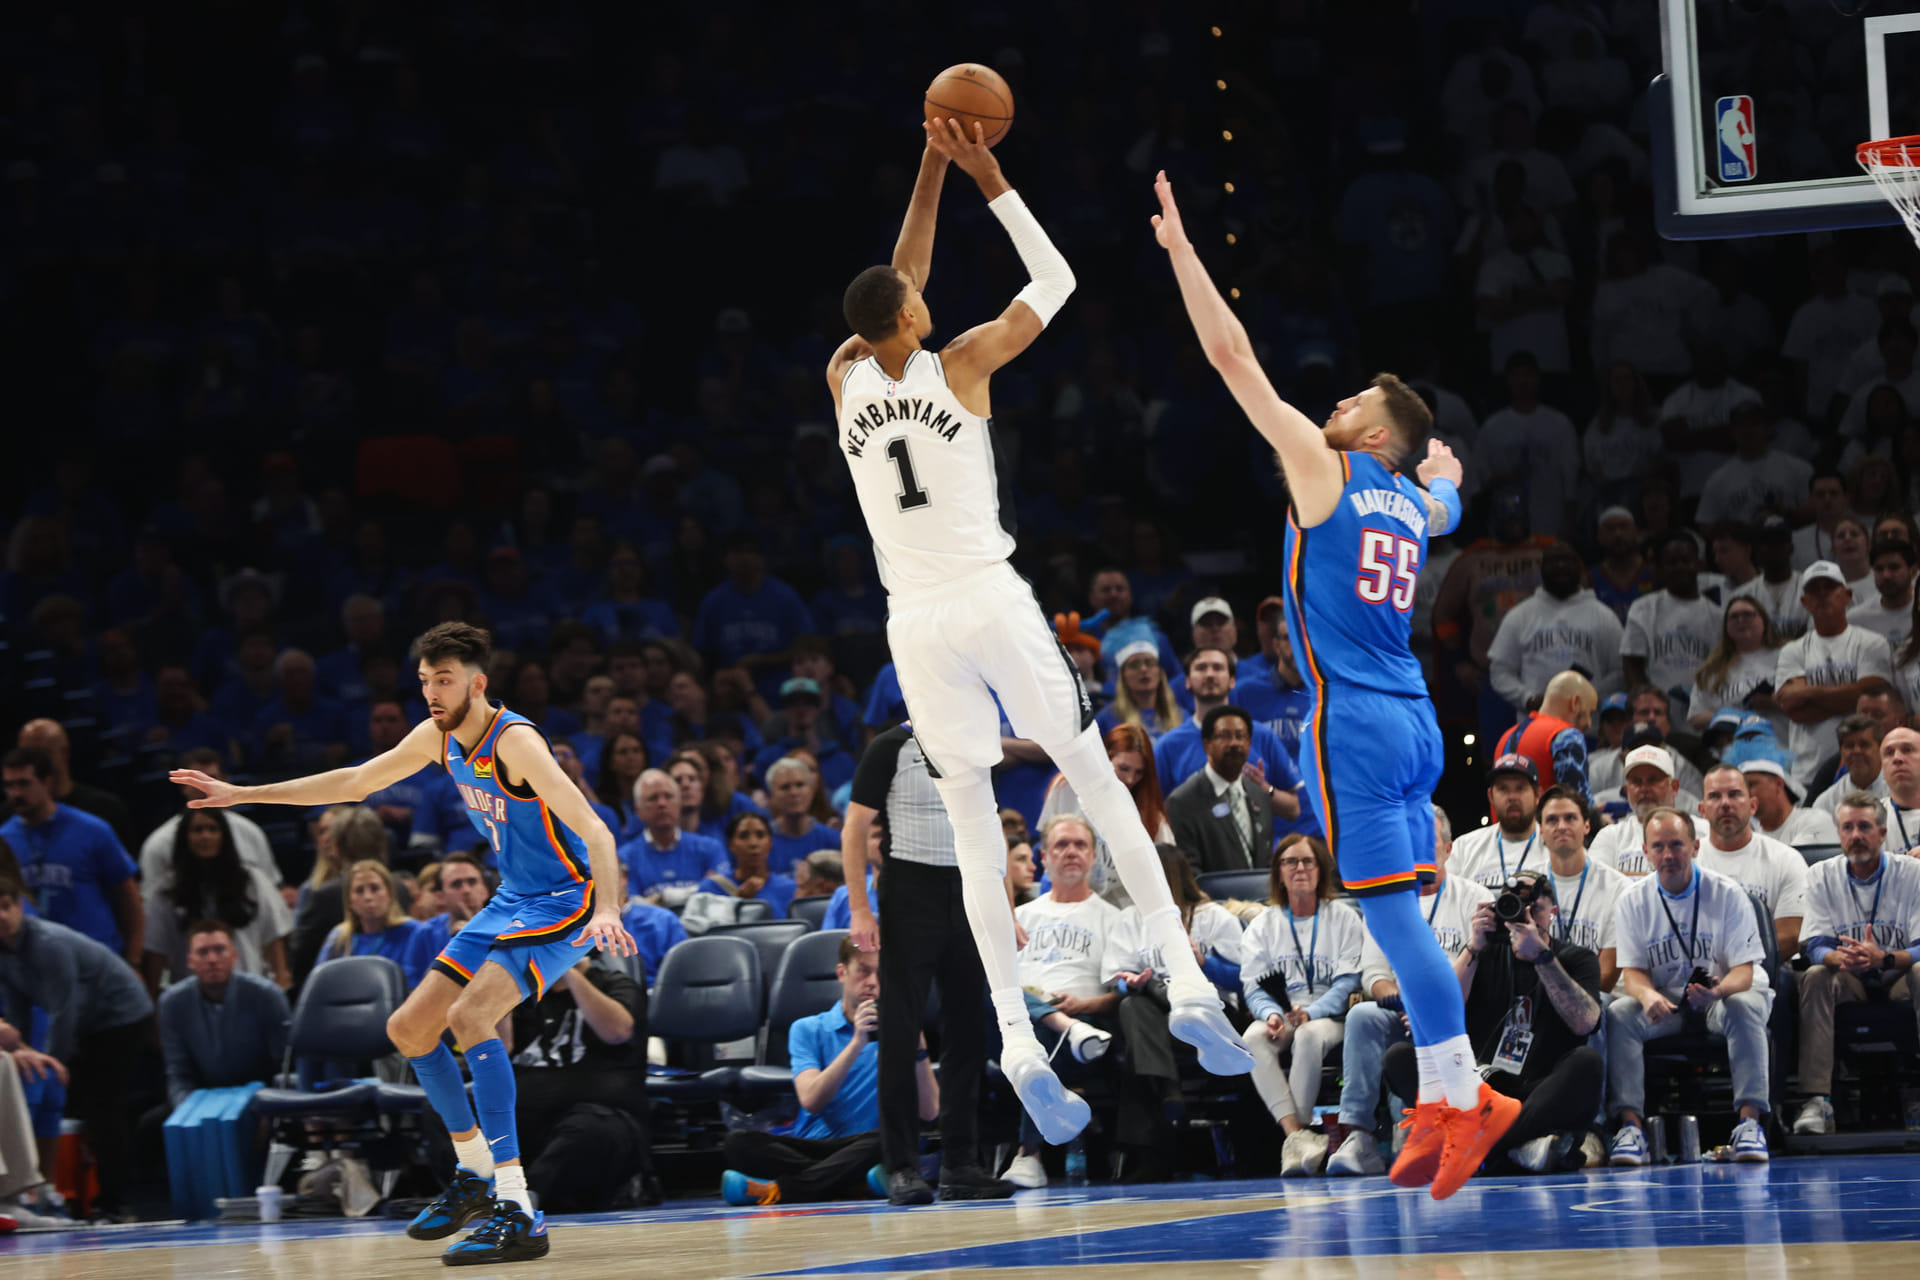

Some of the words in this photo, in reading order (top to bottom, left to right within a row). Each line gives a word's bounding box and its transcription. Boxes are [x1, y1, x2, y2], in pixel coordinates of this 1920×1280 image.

[848, 398, 962, 458] WEMBANYAMA
[884, 435, 932, 513] 1
[1349, 488, 1427, 540] HATENSTEIN
[1355, 527, 1421, 613] 55
[1647, 938, 1718, 968] THUDE
